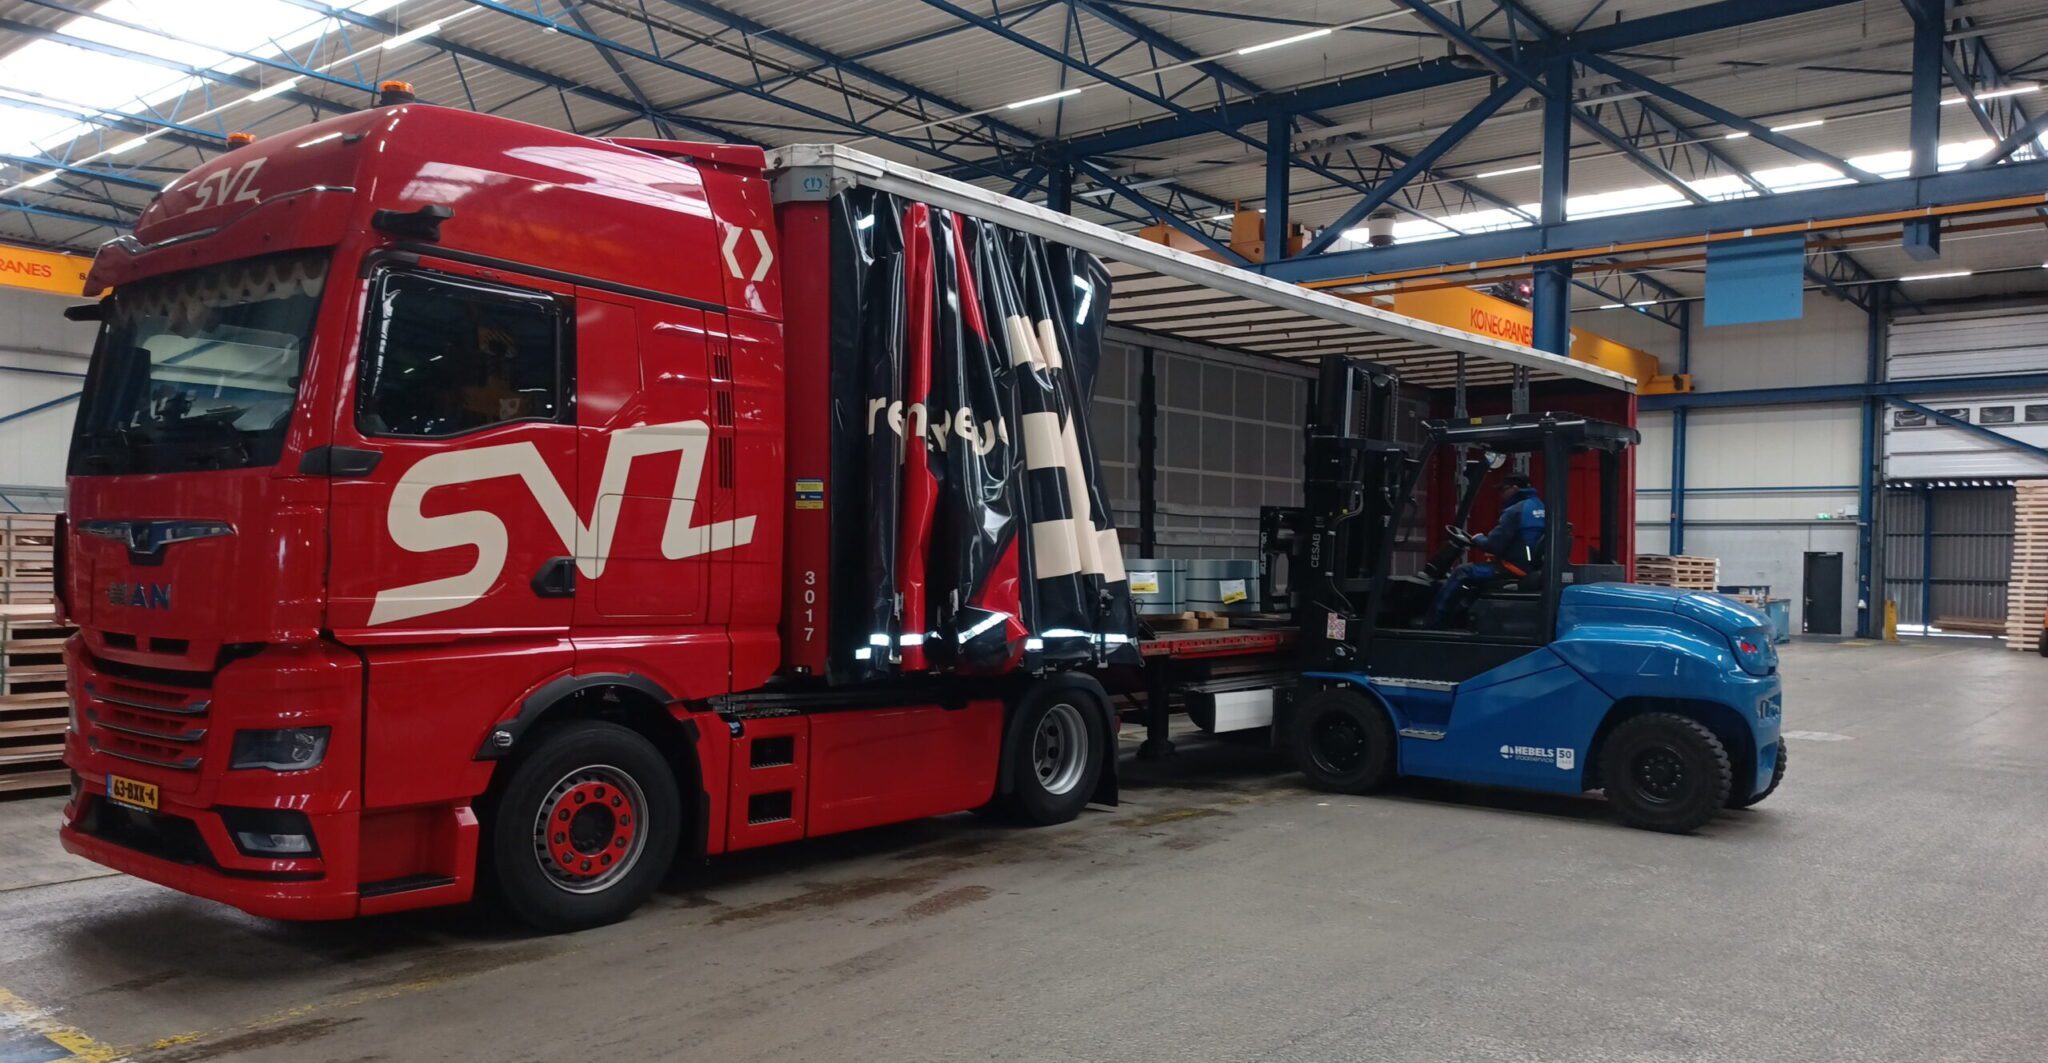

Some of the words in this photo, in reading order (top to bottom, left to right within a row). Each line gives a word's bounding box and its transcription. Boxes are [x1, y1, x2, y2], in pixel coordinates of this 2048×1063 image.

[186, 157, 268, 214] SVZ
[367, 419, 757, 626] SVZ
[1310, 533, 1321, 568] CESAB
[804, 570, 816, 641] 3017
[1514, 746, 1555, 757] HEBELS
[1558, 750, 1572, 759] 50
[114, 779, 155, 805] 63-BXK-4
